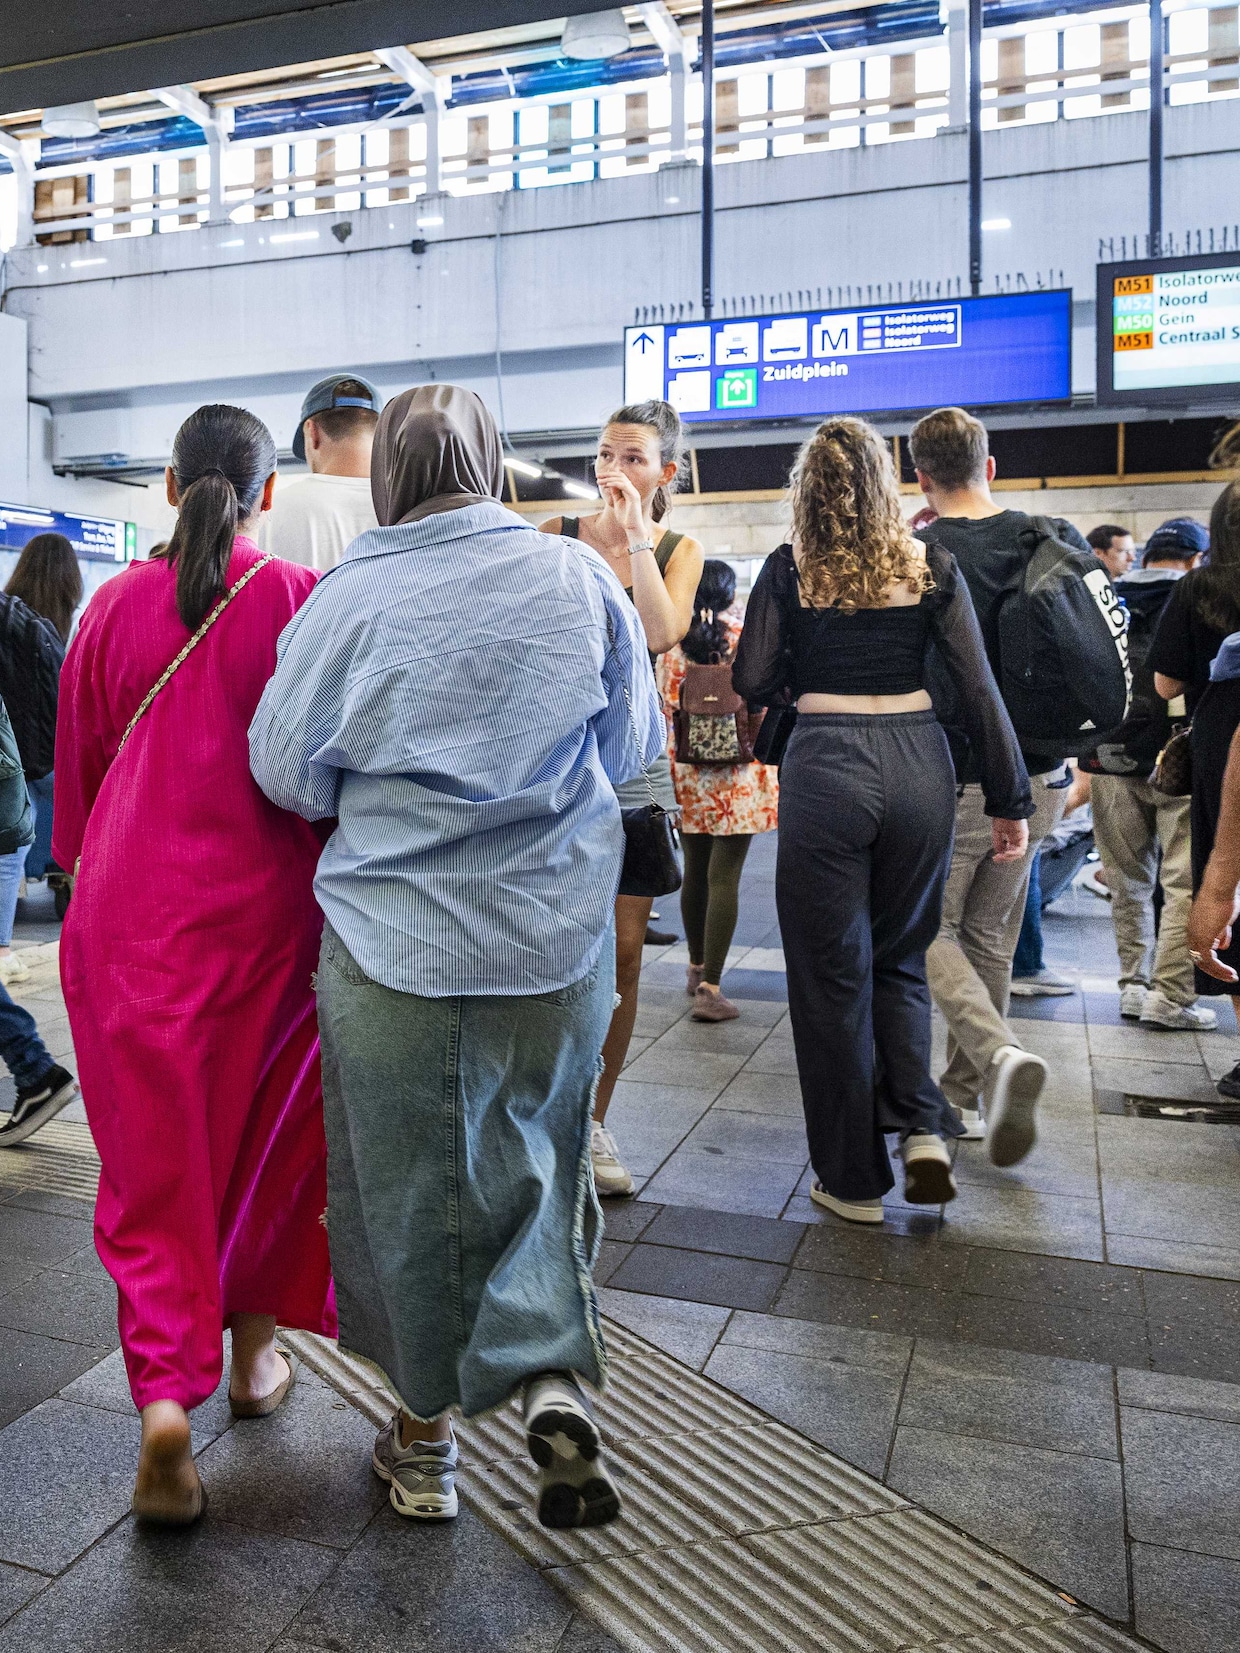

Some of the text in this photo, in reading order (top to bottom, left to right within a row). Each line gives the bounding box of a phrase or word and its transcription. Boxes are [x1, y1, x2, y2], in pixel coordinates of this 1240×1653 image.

[1118, 278, 1151, 292] M51
[1117, 292, 1208, 311] M52 Noord
[1117, 314, 1195, 331] M50 Gein
[821, 328, 848, 351] M
[1118, 333, 1151, 347] M51
[1160, 328, 1226, 344] Centraal
[763, 362, 848, 382] Zuidplein
